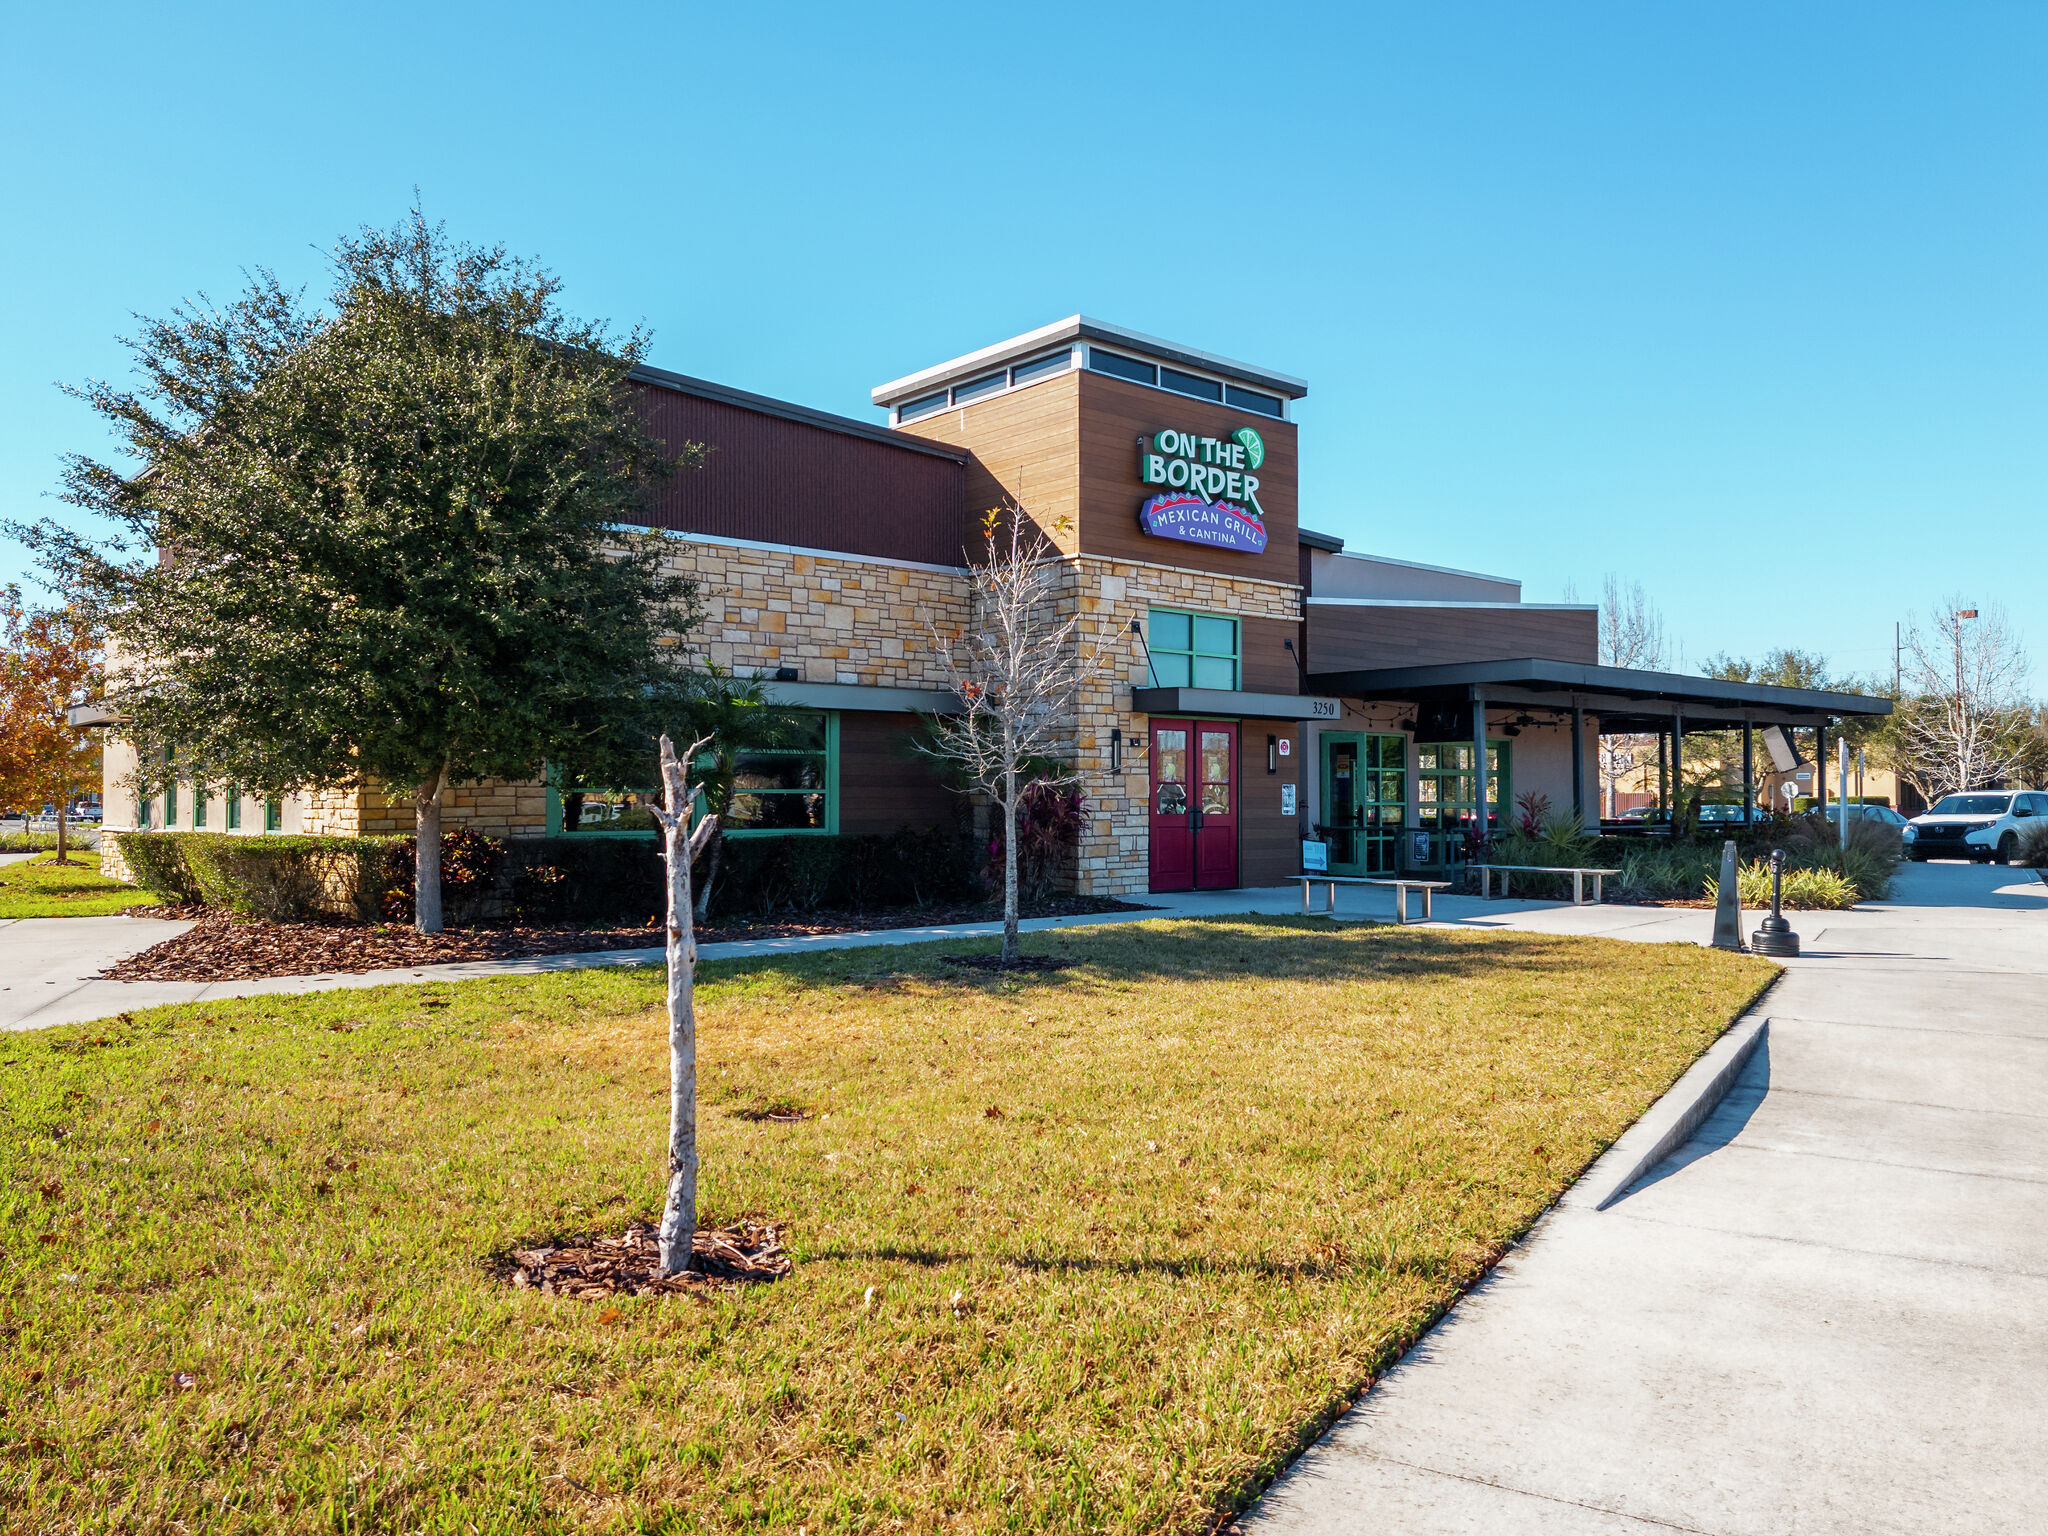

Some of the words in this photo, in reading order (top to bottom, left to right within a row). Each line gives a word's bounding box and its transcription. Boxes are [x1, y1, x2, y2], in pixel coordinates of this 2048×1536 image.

[1160, 429, 1196, 458] ON
[1201, 437, 1245, 470] THE
[1149, 454, 1264, 516] BORDER
[1157, 509, 1219, 527] MEXICAN
[1224, 517, 1257, 545] GRILL
[1178, 525, 1186, 535] &
[1189, 527, 1236, 545] CANTINA
[1312, 701, 1335, 716] 3250
